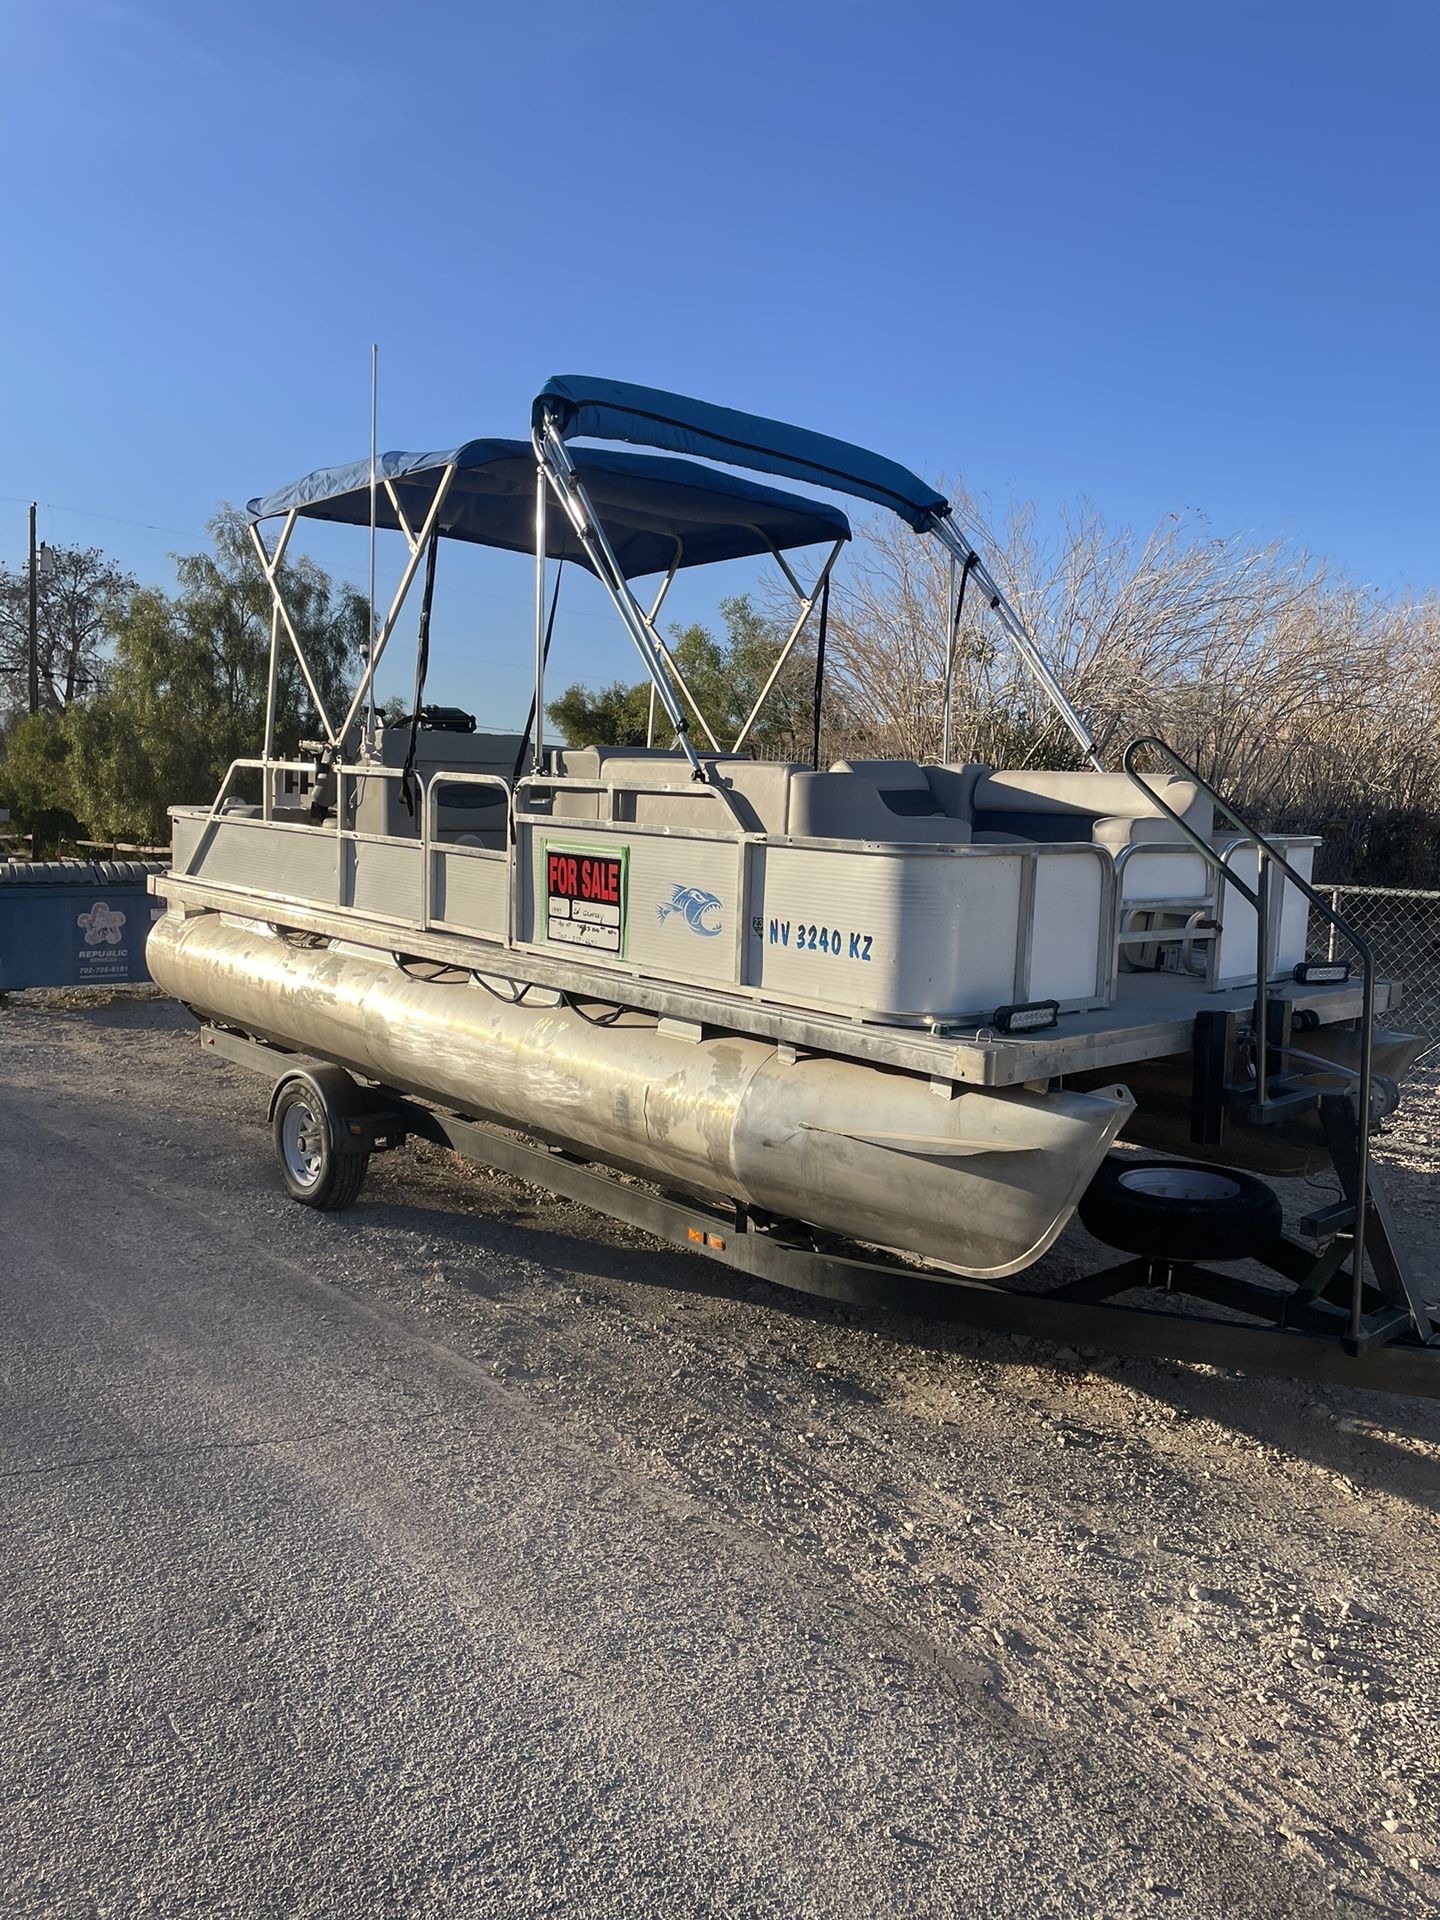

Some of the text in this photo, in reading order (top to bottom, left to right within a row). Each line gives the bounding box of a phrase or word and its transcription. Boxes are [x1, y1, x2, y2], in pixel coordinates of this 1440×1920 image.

[550, 857, 618, 901] FOR SALE
[753, 918, 763, 928] 23
[770, 918, 874, 961] NV 3240 KZ
[79, 949, 128, 958] REPUBLIC
